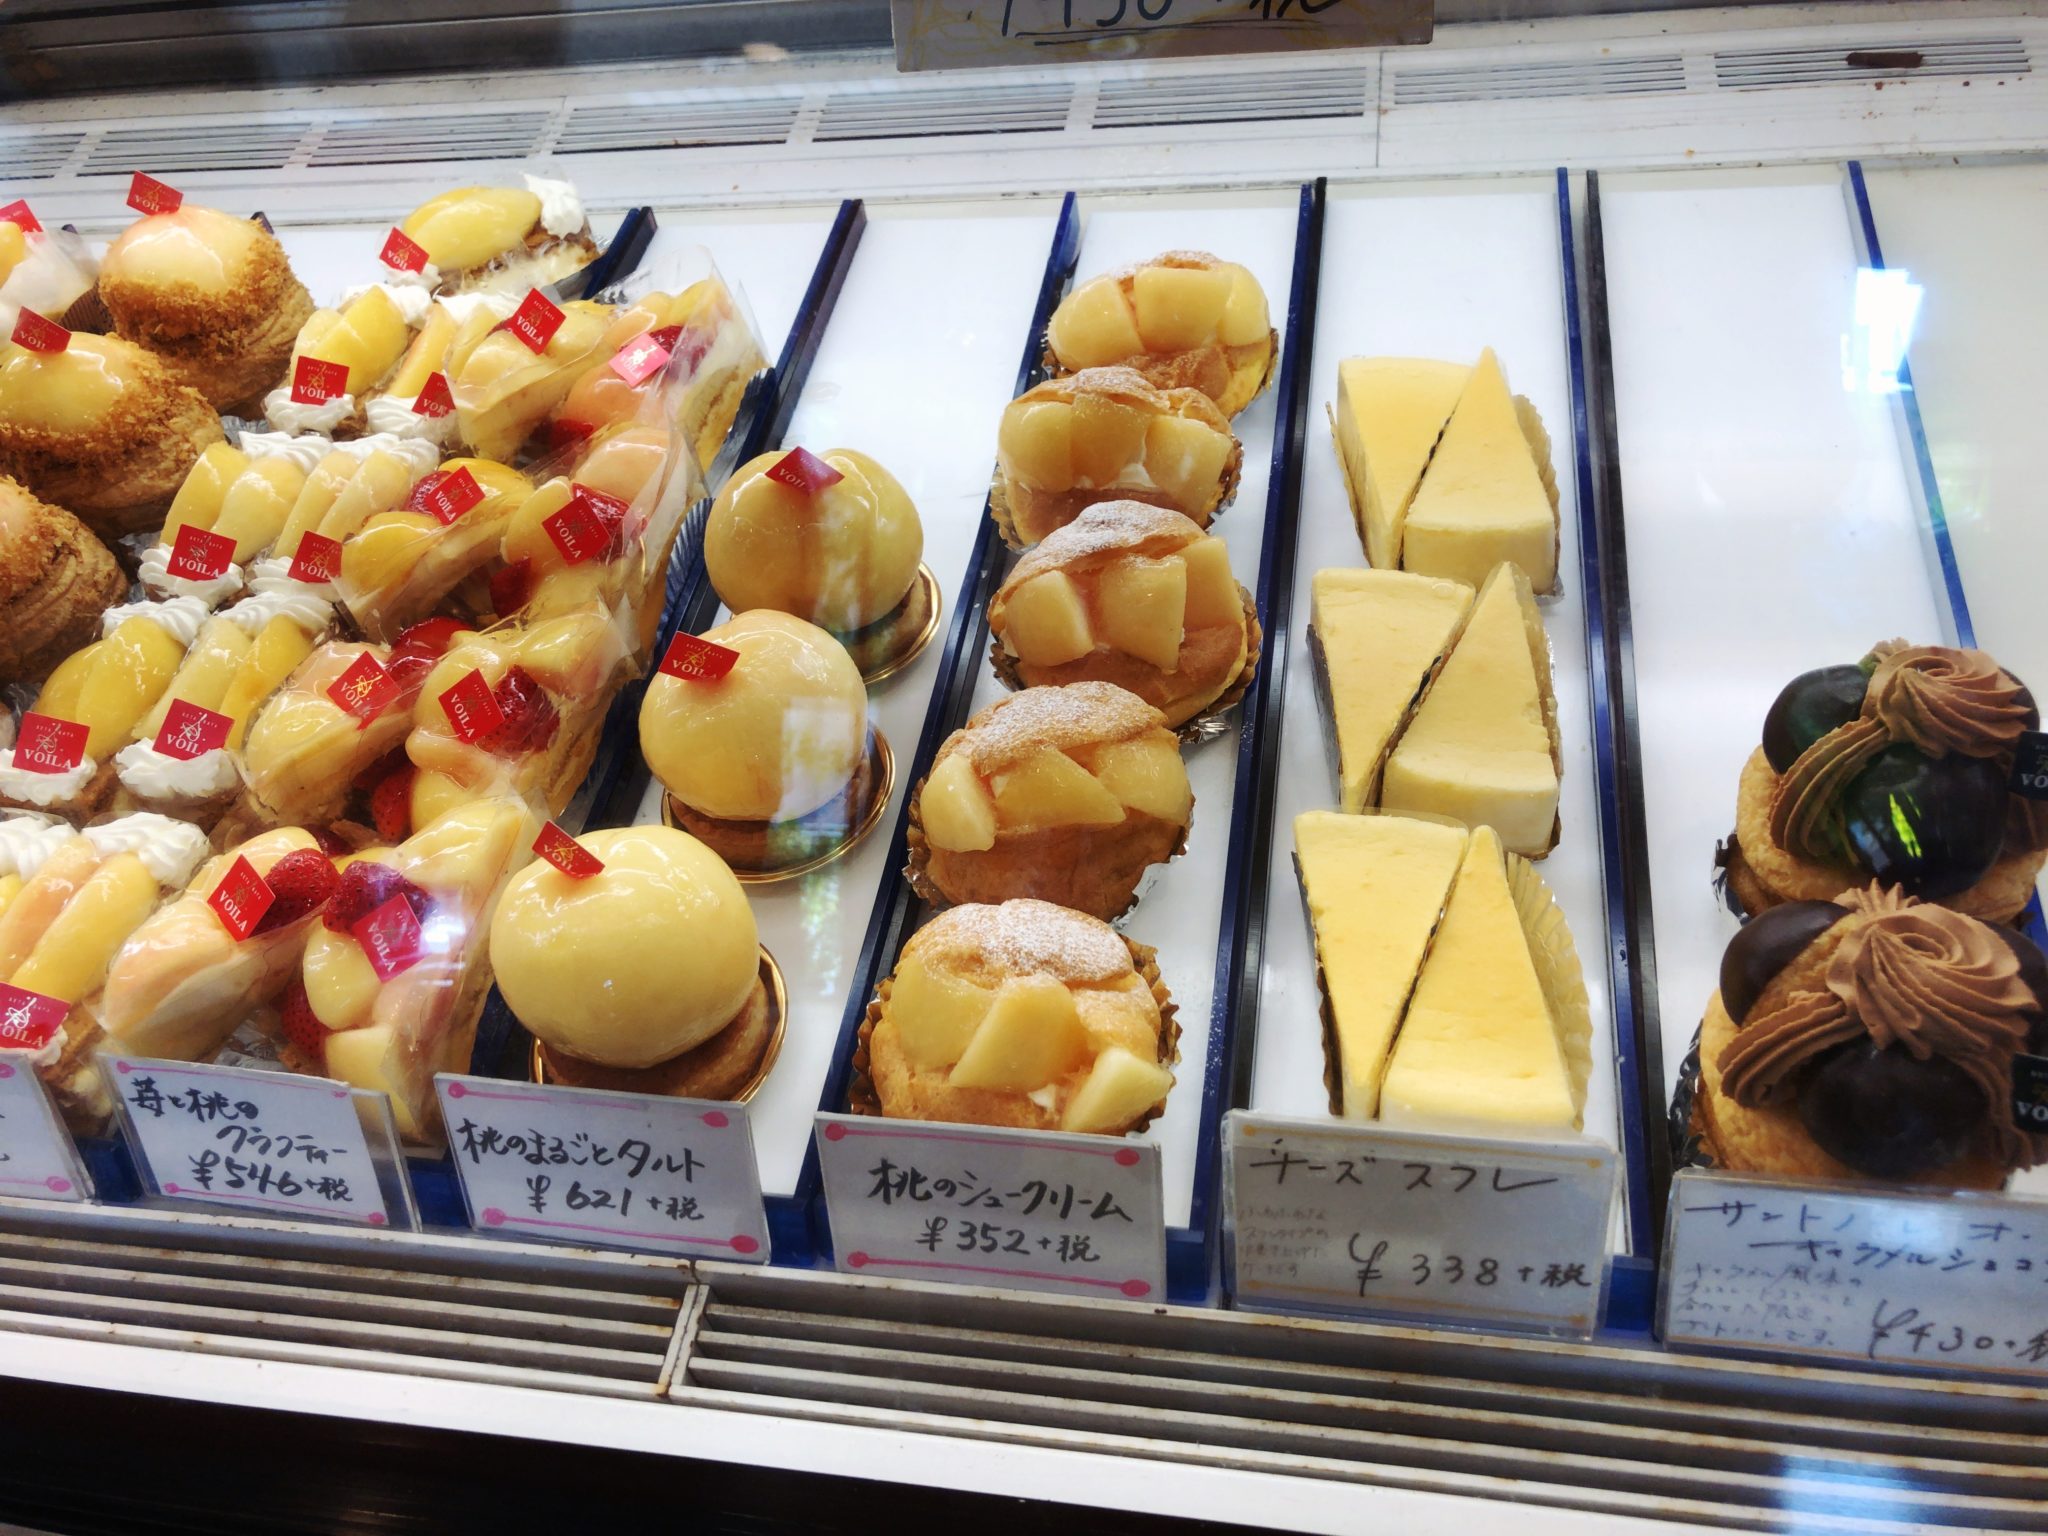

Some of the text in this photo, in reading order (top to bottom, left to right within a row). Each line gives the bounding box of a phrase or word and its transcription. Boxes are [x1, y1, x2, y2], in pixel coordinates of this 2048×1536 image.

[516, 315, 544, 345] VOILA
[434, 490, 457, 521] VOILA
[554, 518, 582, 559] VOILA
[178, 557, 220, 579] VOILA
[450, 693, 475, 738] VOILA
[24, 748, 72, 770] VOILA
[219, 889, 248, 932] VOILA
[367, 922, 397, 973] VOILA
[0, 1023, 44, 1049] OILA
[129, 1076, 259, 1122] 苺と桃の
[456, 1118, 706, 1183] 桃のまるごとタルト
[868, 1157, 1134, 1223] 桃のシュークリーム
